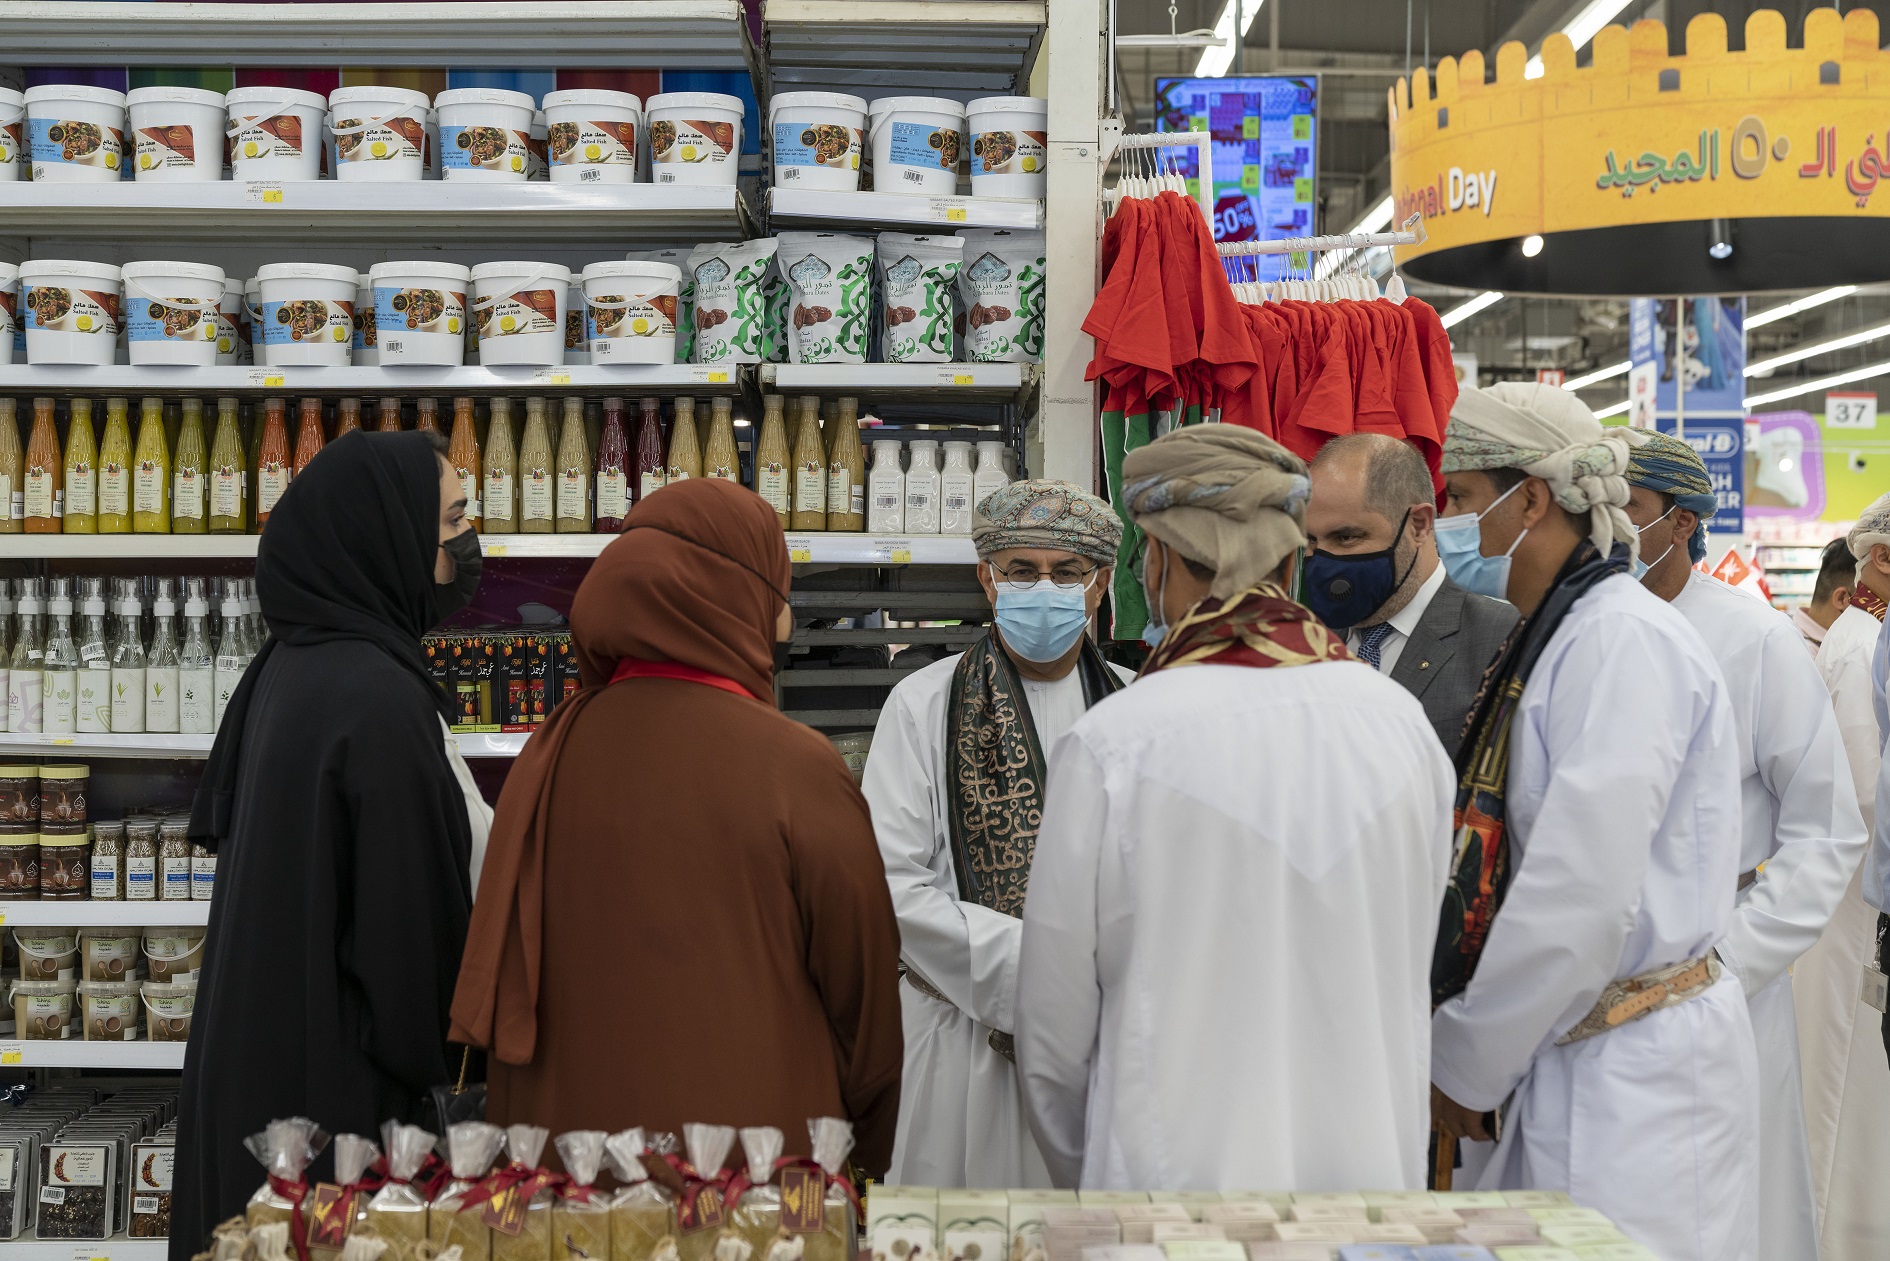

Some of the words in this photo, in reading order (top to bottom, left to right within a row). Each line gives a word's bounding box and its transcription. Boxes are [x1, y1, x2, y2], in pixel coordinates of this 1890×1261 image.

[1596, 127, 1721, 198] المجيد
[1448, 166, 1497, 218] Day
[1834, 402, 1866, 422] 37
[1684, 433, 1734, 452] ral-B
